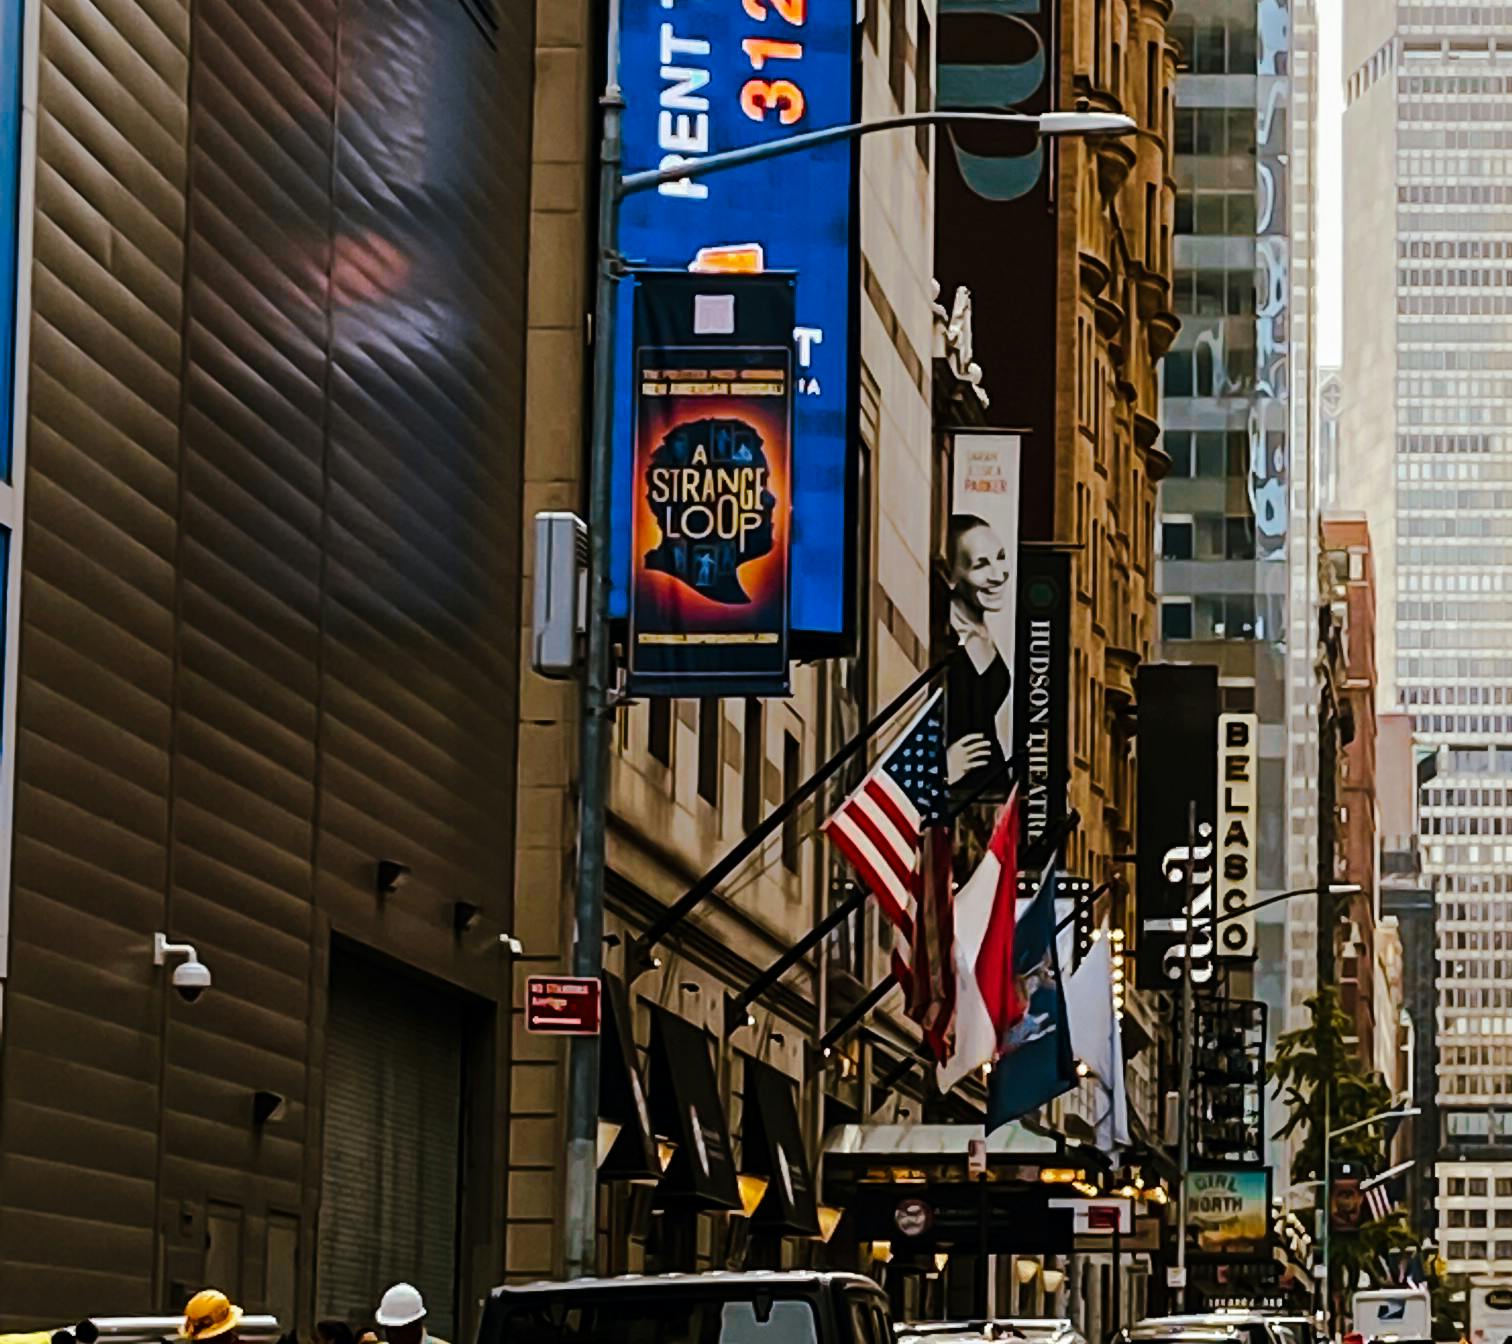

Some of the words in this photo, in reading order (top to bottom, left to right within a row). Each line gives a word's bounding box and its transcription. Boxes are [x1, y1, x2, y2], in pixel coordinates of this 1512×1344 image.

[658, 23, 711, 200] RENT
[652, 467, 766, 511] STRANGE
[692, 444, 708, 464] A
[666, 494, 763, 553] LOOP
[1029, 620, 1051, 722] HUDSON
[1222, 722, 1250, 951] BELASCO
